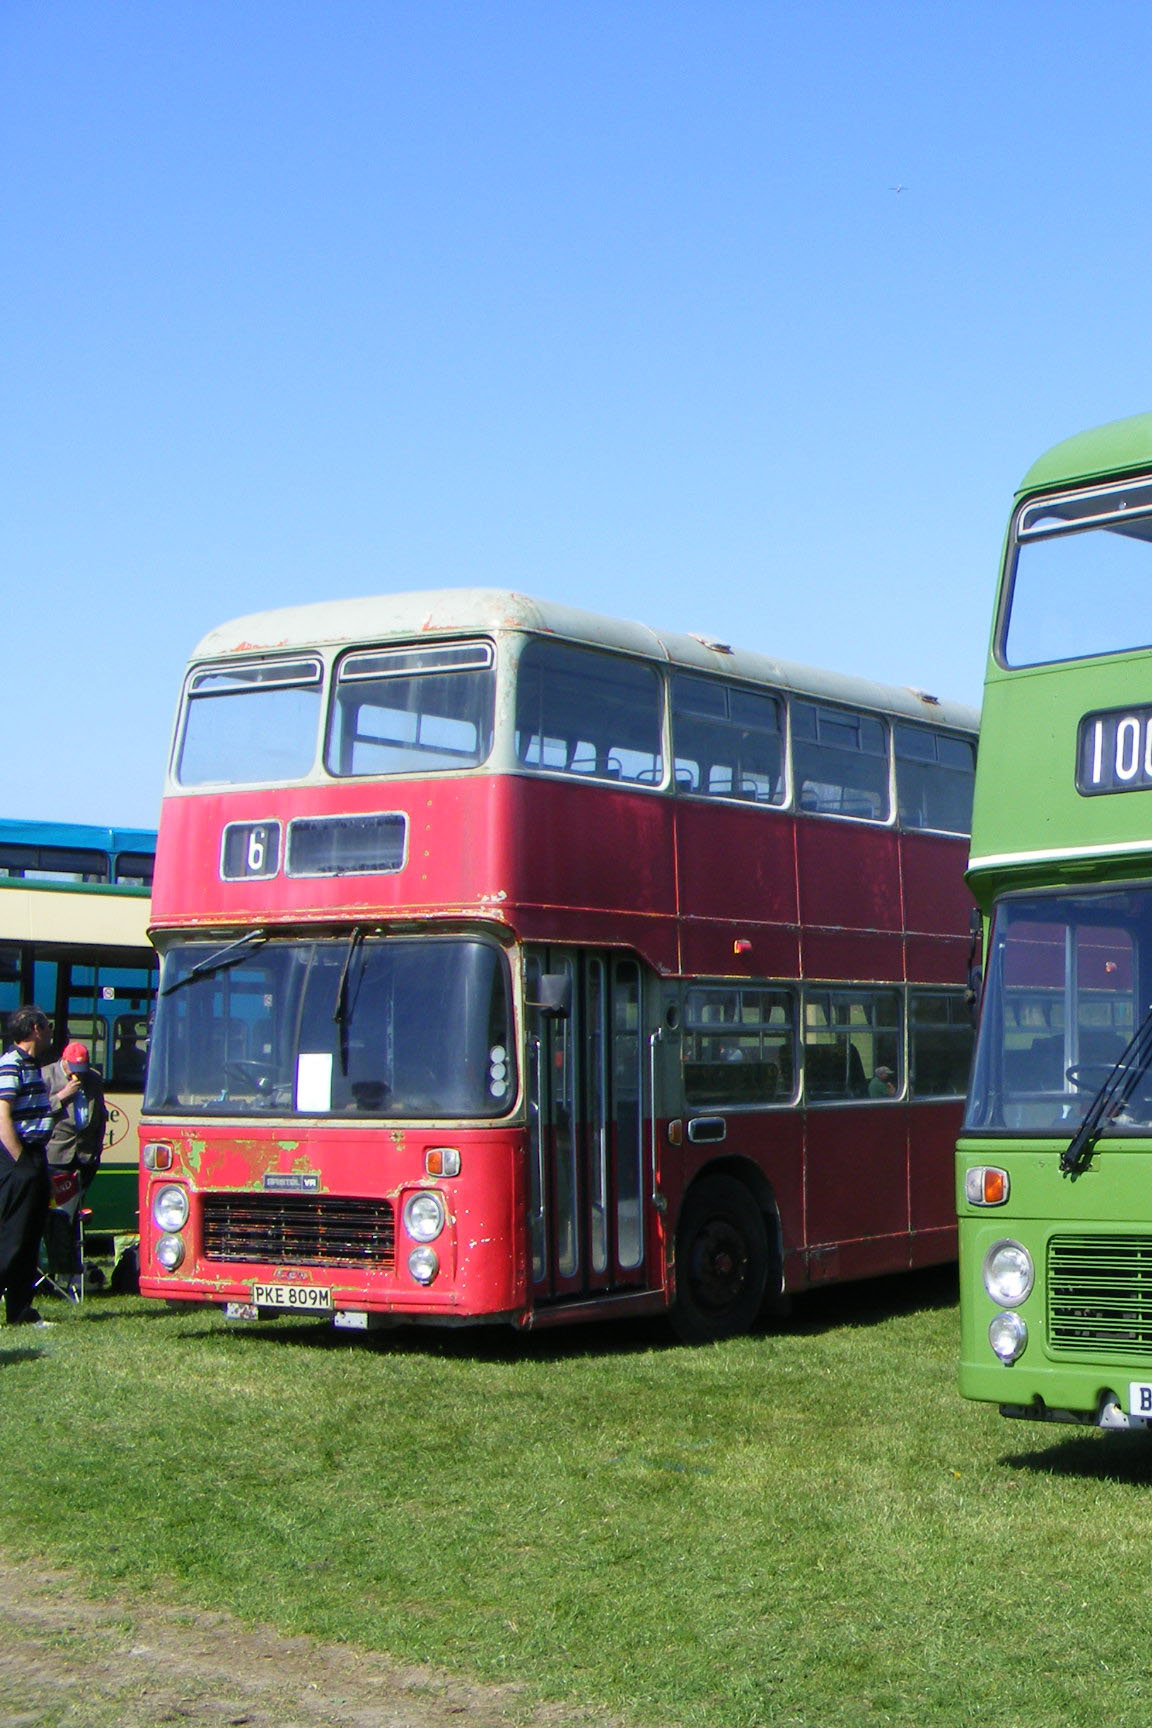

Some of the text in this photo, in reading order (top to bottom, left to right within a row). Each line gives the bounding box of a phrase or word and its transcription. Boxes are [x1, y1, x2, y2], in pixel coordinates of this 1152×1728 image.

[248, 826, 265, 870] 6
[255, 1286, 329, 1306] PKE 809M
